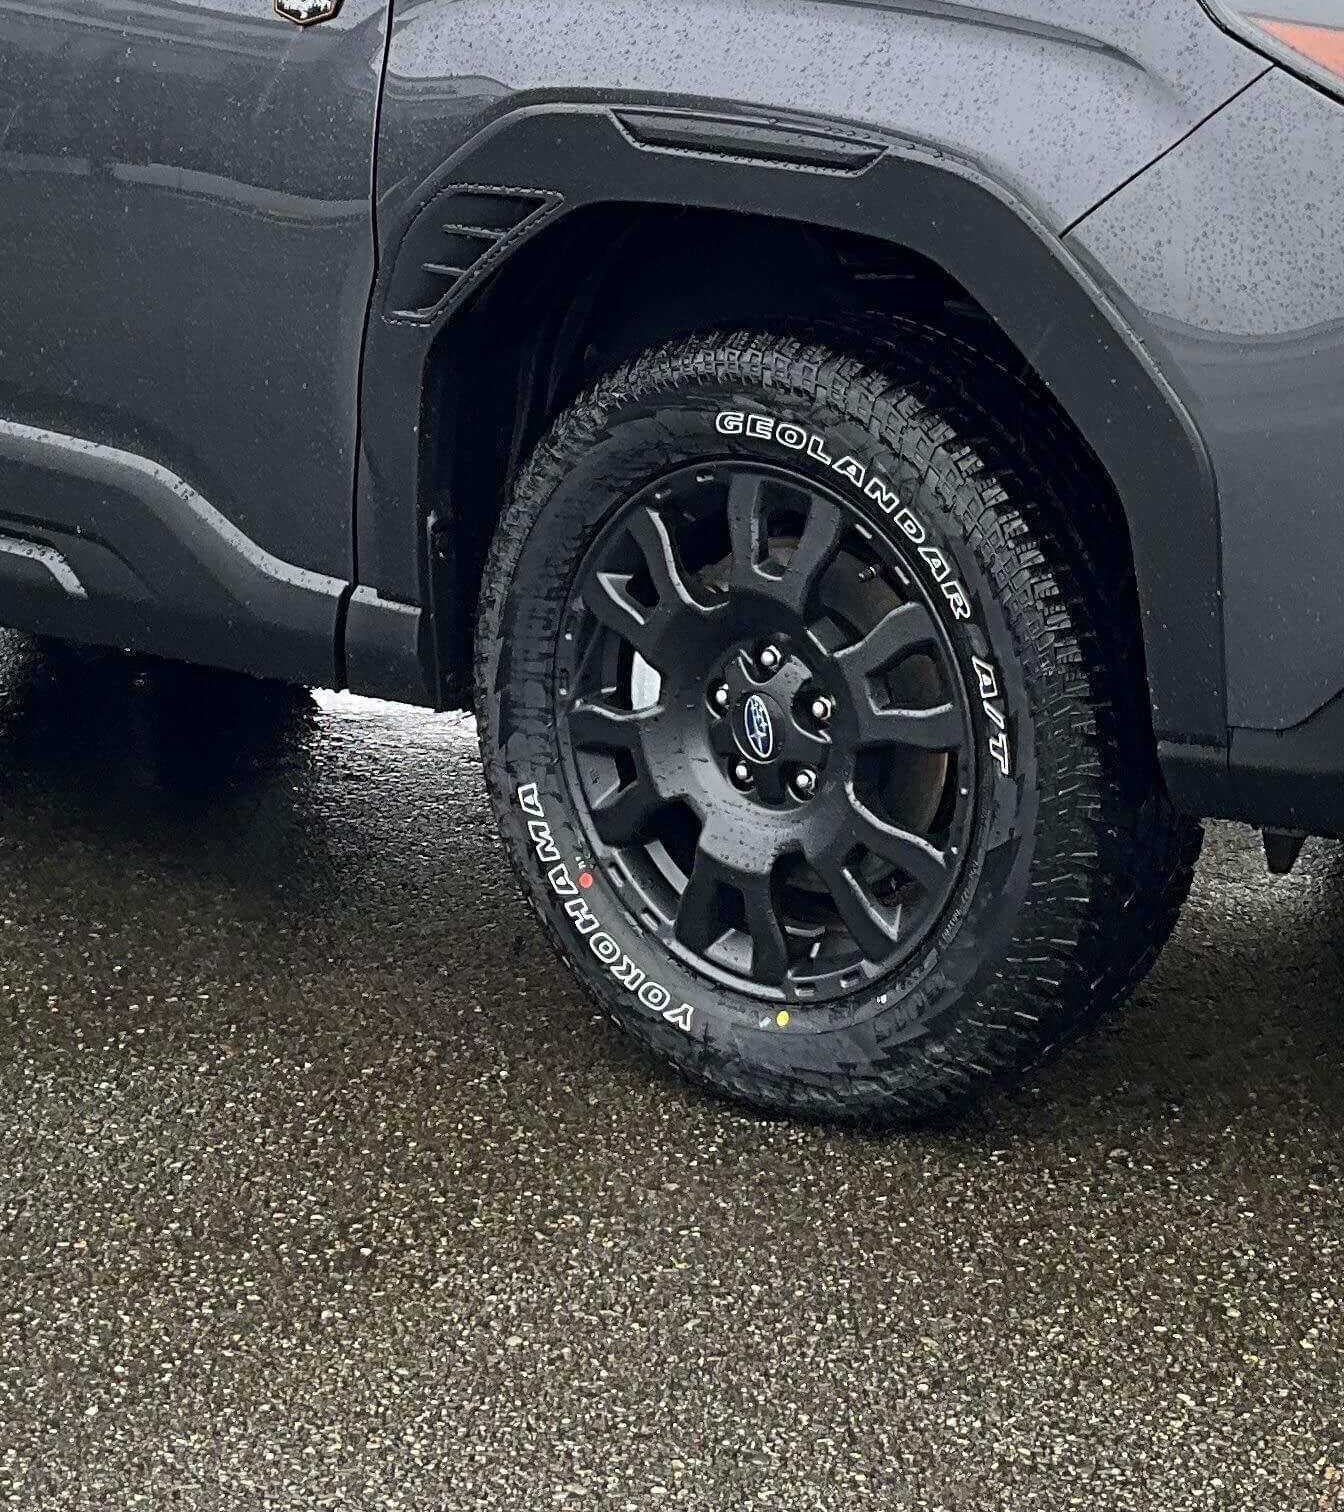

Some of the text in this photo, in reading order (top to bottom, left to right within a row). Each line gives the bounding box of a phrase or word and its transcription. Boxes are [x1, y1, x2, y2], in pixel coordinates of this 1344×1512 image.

[715, 411, 1009, 776] GEOLANDAR A/T
[517, 782, 694, 1032] YOKOHAMA
